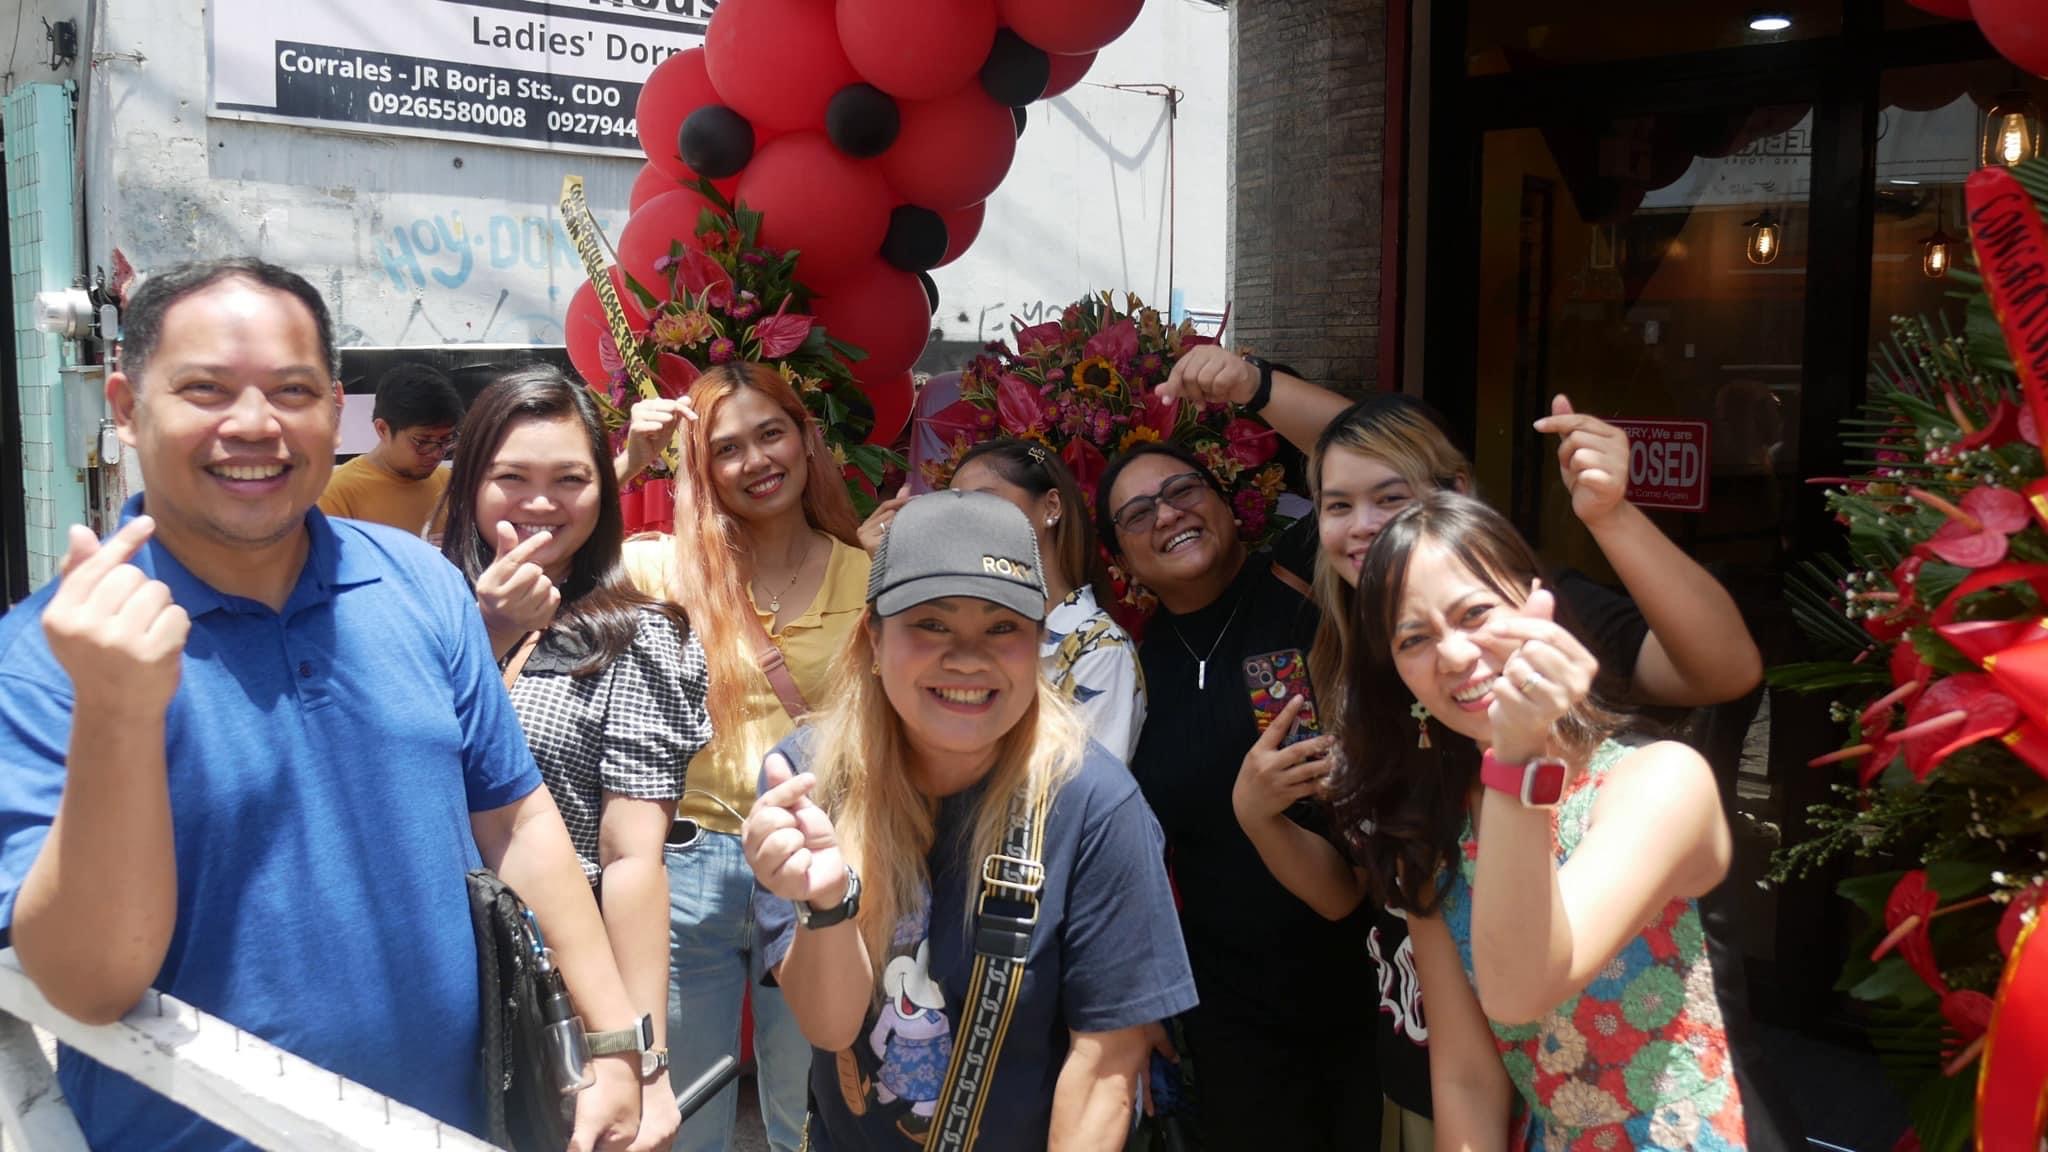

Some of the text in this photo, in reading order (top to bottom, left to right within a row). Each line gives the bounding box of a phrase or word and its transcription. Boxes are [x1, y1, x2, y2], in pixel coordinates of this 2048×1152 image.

[473, 15, 593, 56] Ladies'
[279, 50, 392, 82] Corrales
[411, 65, 439, 91] JR
[447, 69, 510, 99] Borja
[517, 78, 565, 105] Sts.,
[572, 84, 620, 107] CDO
[369, 91, 527, 128] 09265580008
